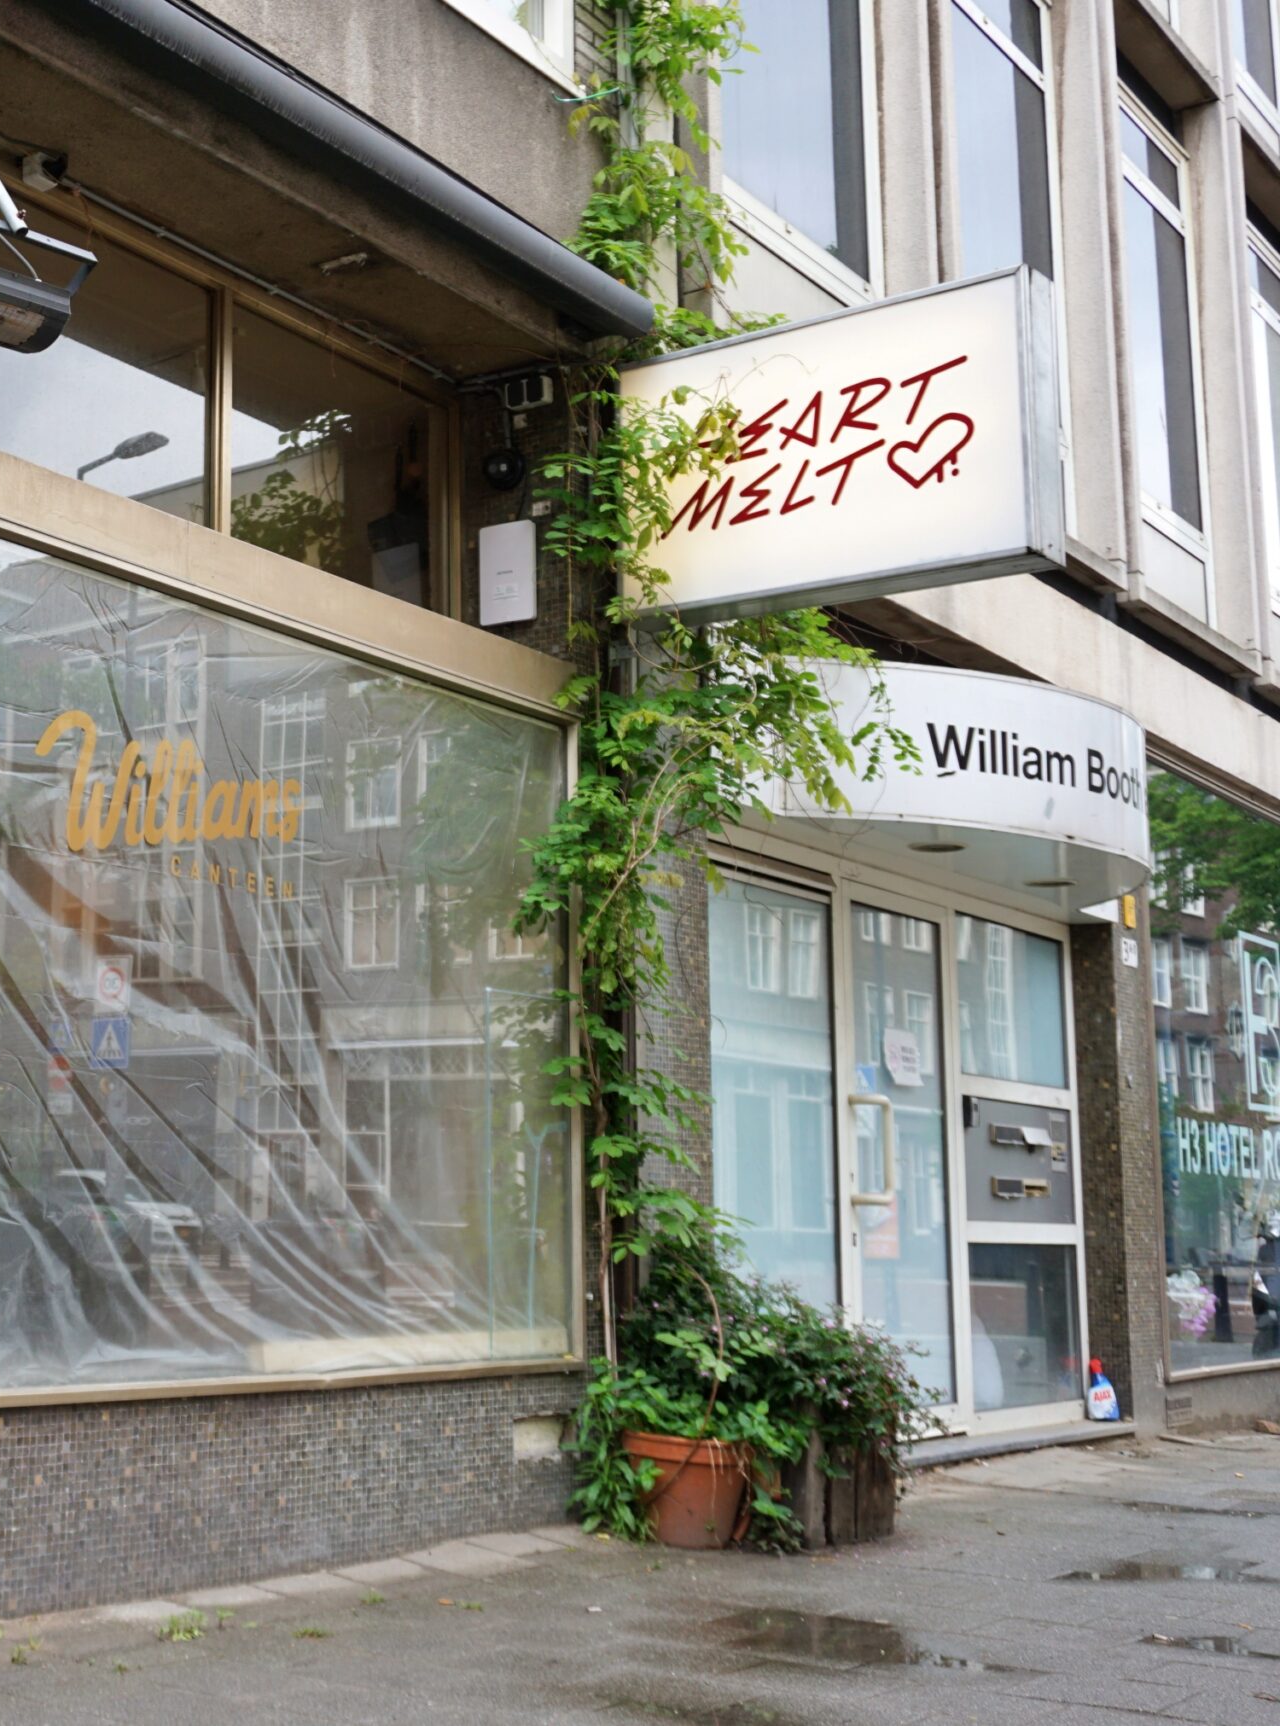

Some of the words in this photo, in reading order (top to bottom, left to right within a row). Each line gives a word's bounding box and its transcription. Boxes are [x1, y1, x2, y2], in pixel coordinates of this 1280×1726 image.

[697, 354, 968, 465] EART
[660, 437, 886, 540] MELT
[34, 709, 302, 851] Williams
[926, 721, 1076, 787] William
[170, 855, 293, 898] CANTEEN
[1176, 1116, 1201, 1175] H3
[1203, 1120, 1261, 1178] HOTEL
